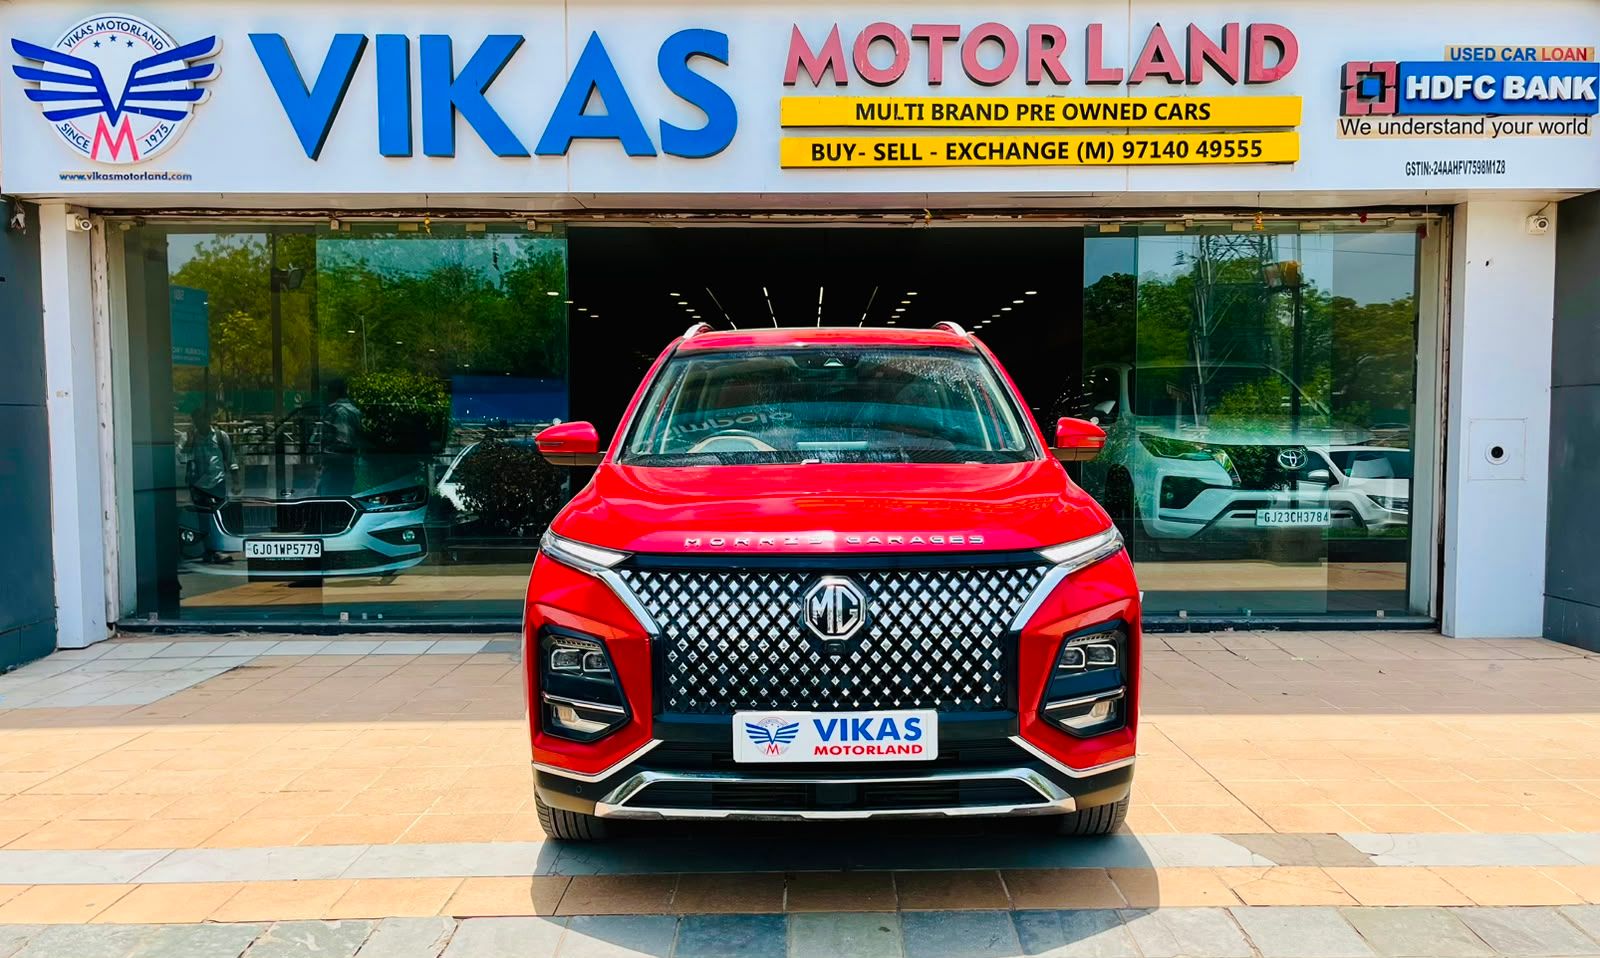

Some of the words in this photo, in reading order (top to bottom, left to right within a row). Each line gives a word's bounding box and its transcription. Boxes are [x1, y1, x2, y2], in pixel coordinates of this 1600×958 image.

[63, 24, 95, 48] VIKAS
[95, 20, 164, 51] MOTORLAND
[782, 22, 1299, 87] MOTORLAND
[1450, 47, 1496, 61] USED
[1500, 47, 1537, 61] CAR
[1541, 47, 1588, 61] LOAN
[247, 28, 739, 161] VIKAS
[1406, 75, 1496, 100] HDFC
[1502, 75, 1597, 100] BANK
[855, 103, 924, 121] MULTI
[931, 103, 1009, 121] BRAND
[1016, 103, 1055, 121] PRE
[1062, 103, 1147, 121] OWNED
[1154, 102, 1211, 120] CARS
[60, 123, 91, 150] SINCE
[144, 124, 170, 148] 1975
[1339, 118, 1371, 135] We
[1378, 118, 1485, 135] understand
[1491, 121, 1533, 138] your
[1538, 118, 1588, 135] world
[873, 143, 922, 161] SELL
[946, 142, 1069, 161] EXCHANGE
[1077, 141, 1115, 163] (M)
[1122, 140, 1189, 160] 97140
[1195, 139, 1263, 158] 49555
[59, 171, 193, 181] www.vikasmotorland.com
[1264, 511, 1329, 523] GJ23CH3784
[252, 542, 320, 555] GJ01WP5779
[846, 535, 985, 545] GARAGES
[811, 585, 859, 634] MG
[813, 717, 922, 742] VIKAS
[814, 744, 923, 756] MOTORLAND
